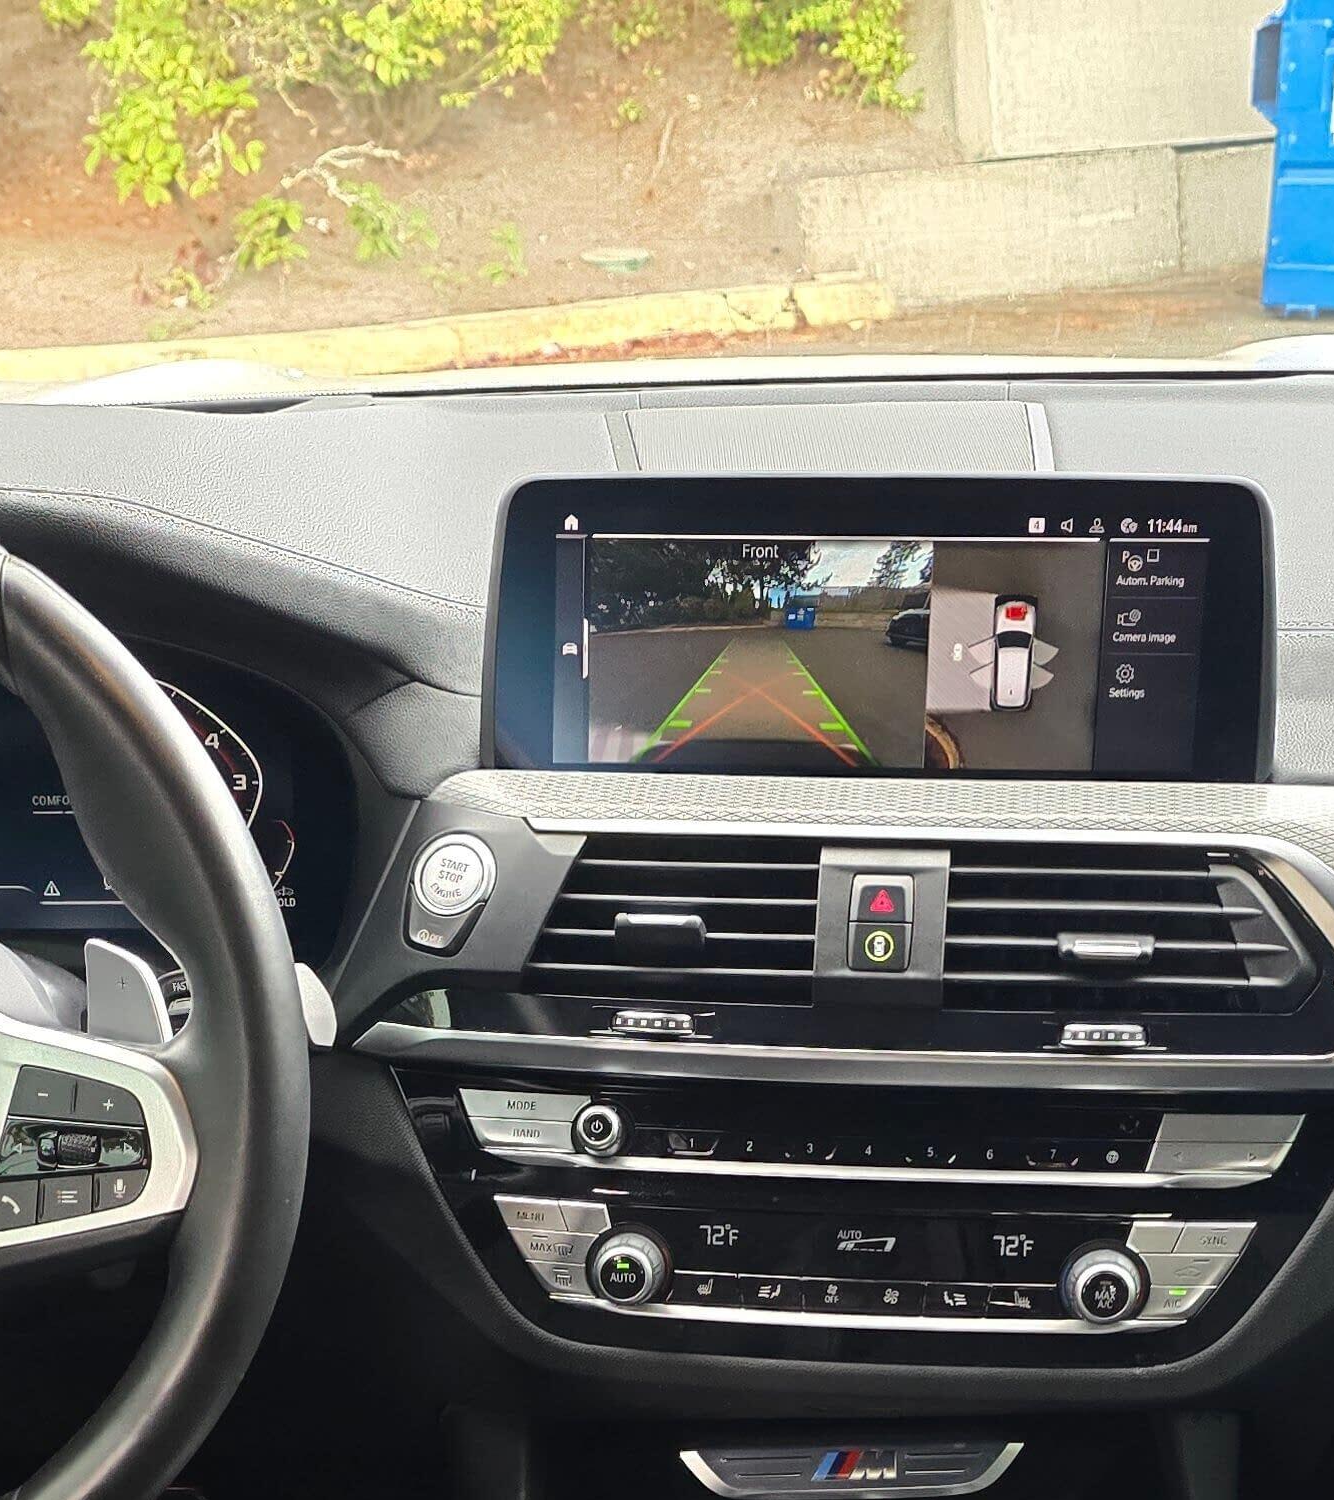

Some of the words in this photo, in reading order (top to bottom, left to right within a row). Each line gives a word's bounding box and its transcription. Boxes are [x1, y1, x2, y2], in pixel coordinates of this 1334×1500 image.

[742, 543, 779, 558] Front
[1150, 575, 1185, 588] Parking
[1112, 631, 1147, 643] Camera
[1148, 632, 1176, 643] image
[1109, 686, 1145, 698] Settings
[205, 733, 219, 749] 4
[233, 774, 247, 791] 3
[32, 795, 70, 806] COMFO
[440, 858, 470, 873] START
[438, 870, 463, 883] STOP
[430, 882, 462, 899] ENGINE
[277, 898, 296, 907] OLD
[172, 982, 189, 991] FAS
[506, 1100, 536, 1111] MODE
[689, 1137, 695, 1148] 1
[746, 1141, 753, 1152] 2
[806, 1143, 814, 1154] 3
[864, 1145, 872, 1156] 4
[926, 1147, 934, 1158] 5
[1050, 1148, 1057, 1160] 7
[986, 1149, 994, 1160] 6
[837, 1230, 862, 1240] AUTO
[1200, 1235, 1228, 1246] SYNC
[530, 1241, 552, 1252] MAX
[610, 1272, 636, 1283] AUTO
[824, 1295, 839, 1304] OFF
[1095, 1290, 1116, 1301] MAX
